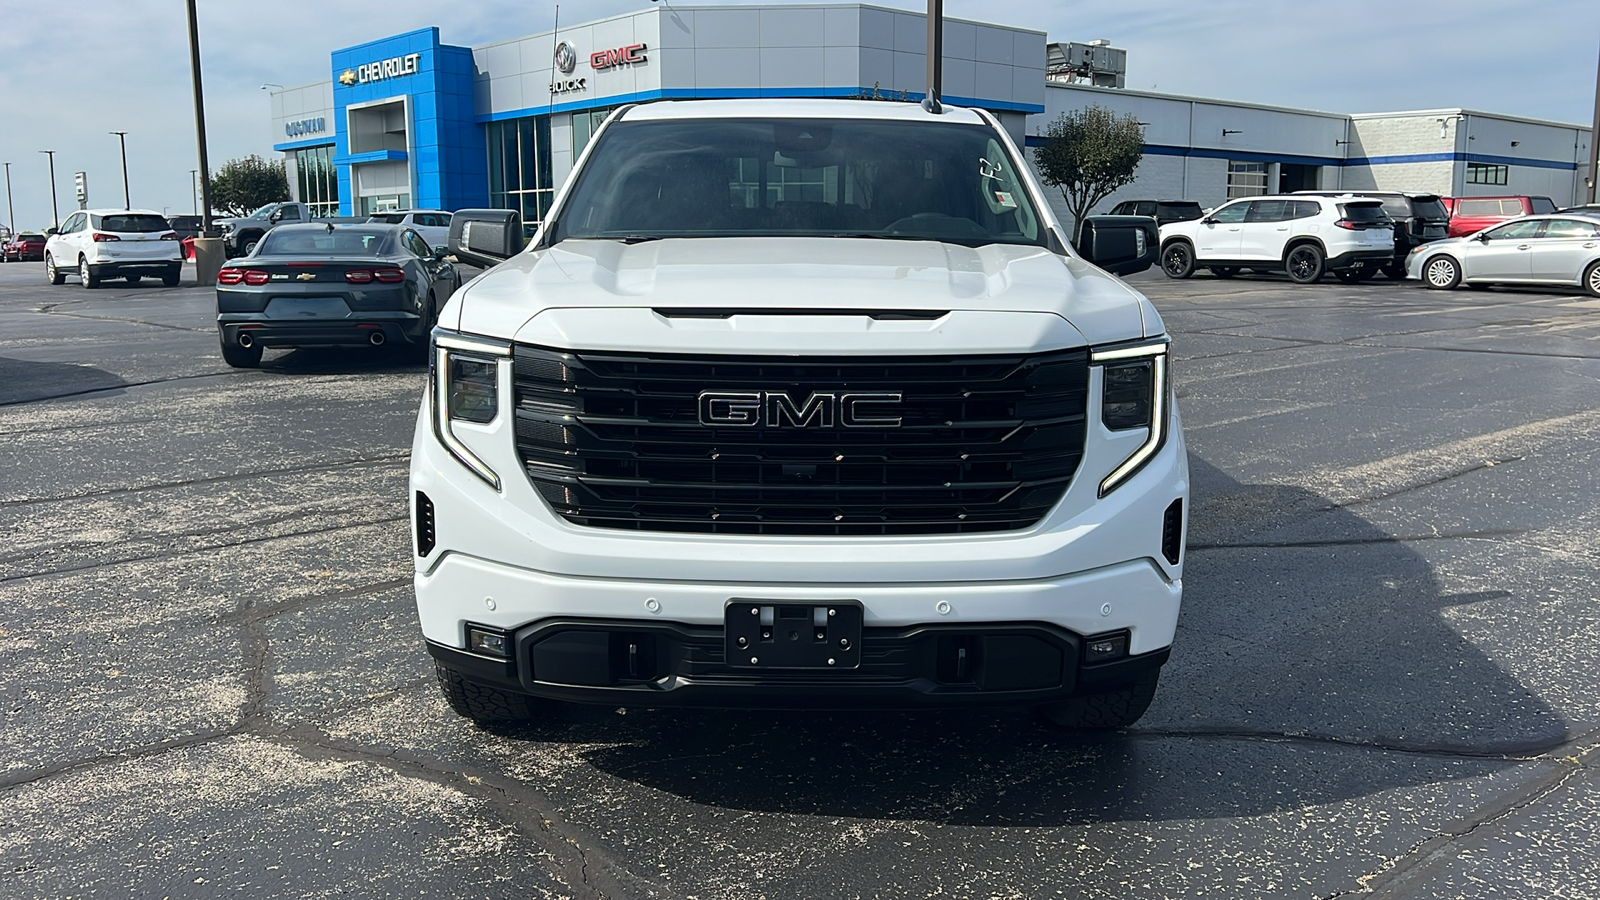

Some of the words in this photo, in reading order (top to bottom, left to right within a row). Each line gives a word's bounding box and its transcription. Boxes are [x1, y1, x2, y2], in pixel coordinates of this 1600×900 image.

[358, 53, 420, 83] CHEVROLET
[590, 44, 647, 69] GMC
[698, 390, 903, 429] GMC
